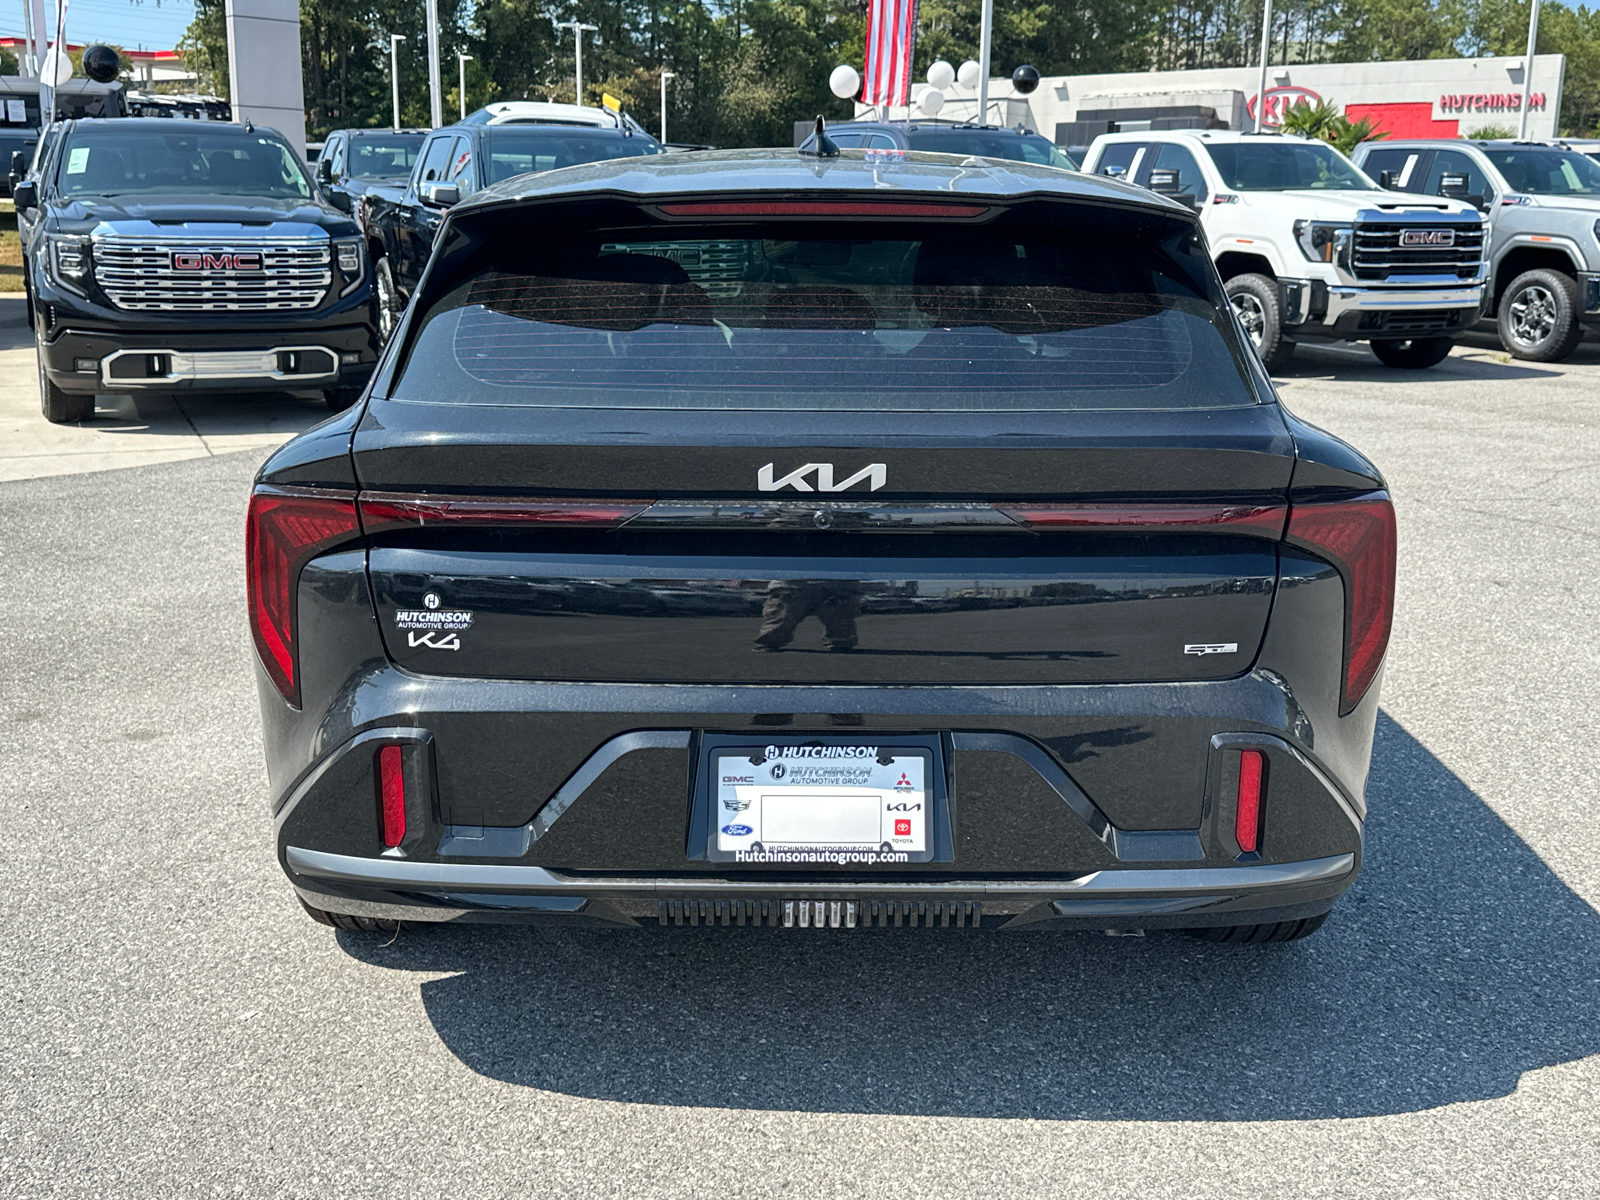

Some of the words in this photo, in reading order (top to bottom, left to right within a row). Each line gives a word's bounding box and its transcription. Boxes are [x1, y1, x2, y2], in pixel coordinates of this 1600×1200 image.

[1440, 93, 1545, 109] HUTCHINSN
[1405, 232, 1452, 244] GMC
[175, 254, 260, 269] GMC
[757, 462, 887, 492] KIA
[396, 612, 471, 622] HUTCHINSON
[408, 631, 460, 651] K4
[781, 746, 878, 759] HUTCHINSON
[789, 766, 872, 777] HUTCHINSON
[722, 775, 754, 783] GMC
[886, 803, 921, 811] KIA
[727, 825, 749, 835] Ford
[735, 850, 909, 865] Hutchinsonautogroup.com
